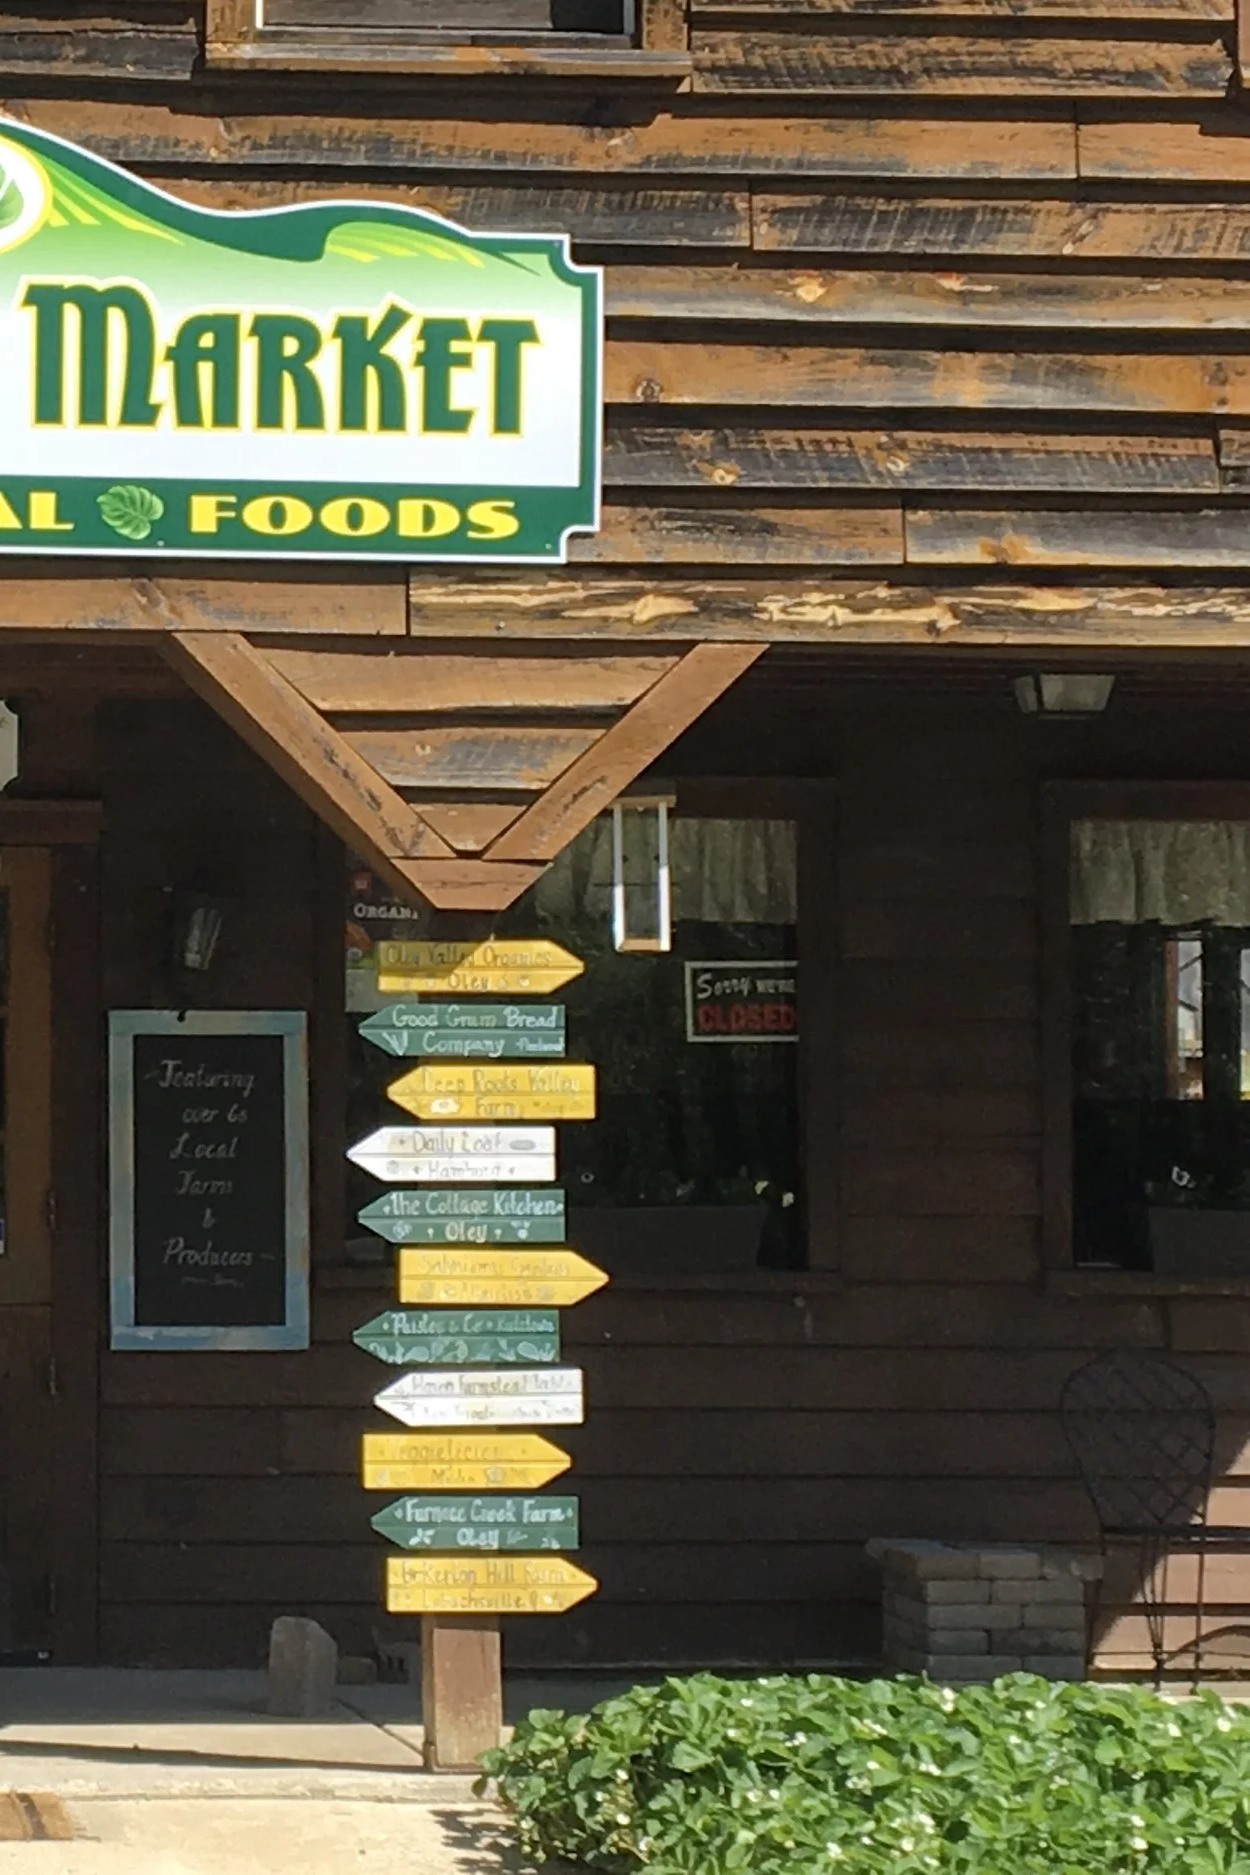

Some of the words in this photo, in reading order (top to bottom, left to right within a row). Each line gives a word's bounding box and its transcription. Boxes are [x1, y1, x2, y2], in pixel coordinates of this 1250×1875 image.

[190, 494, 520, 539] FOODS
[449, 974, 489, 990] Oley
[697, 972, 750, 999] Sorry
[393, 1004, 438, 1027] Good
[504, 1006, 558, 1028] Bread
[696, 1004, 796, 1031] CLOSED
[422, 1031, 505, 1057] Company
[158, 1059, 255, 1097] Featuring
[182, 1106, 218, 1124] over
[169, 1133, 238, 1159] Local
[413, 1131, 454, 1156] Daily
[462, 1132, 501, 1154] Loaf
[176, 1169, 233, 1195] Farms
[426, 1192, 488, 1220] Cottage
[493, 1190, 557, 1215] Kitchen
[445, 1223, 488, 1243] Oley
[162, 1237, 253, 1266] Producers
[406, 1499, 467, 1523] Furnace
[470, 1499, 516, 1523] Creek
[523, 1499, 565, 1523] Farm
[456, 1528, 500, 1550] Oley
